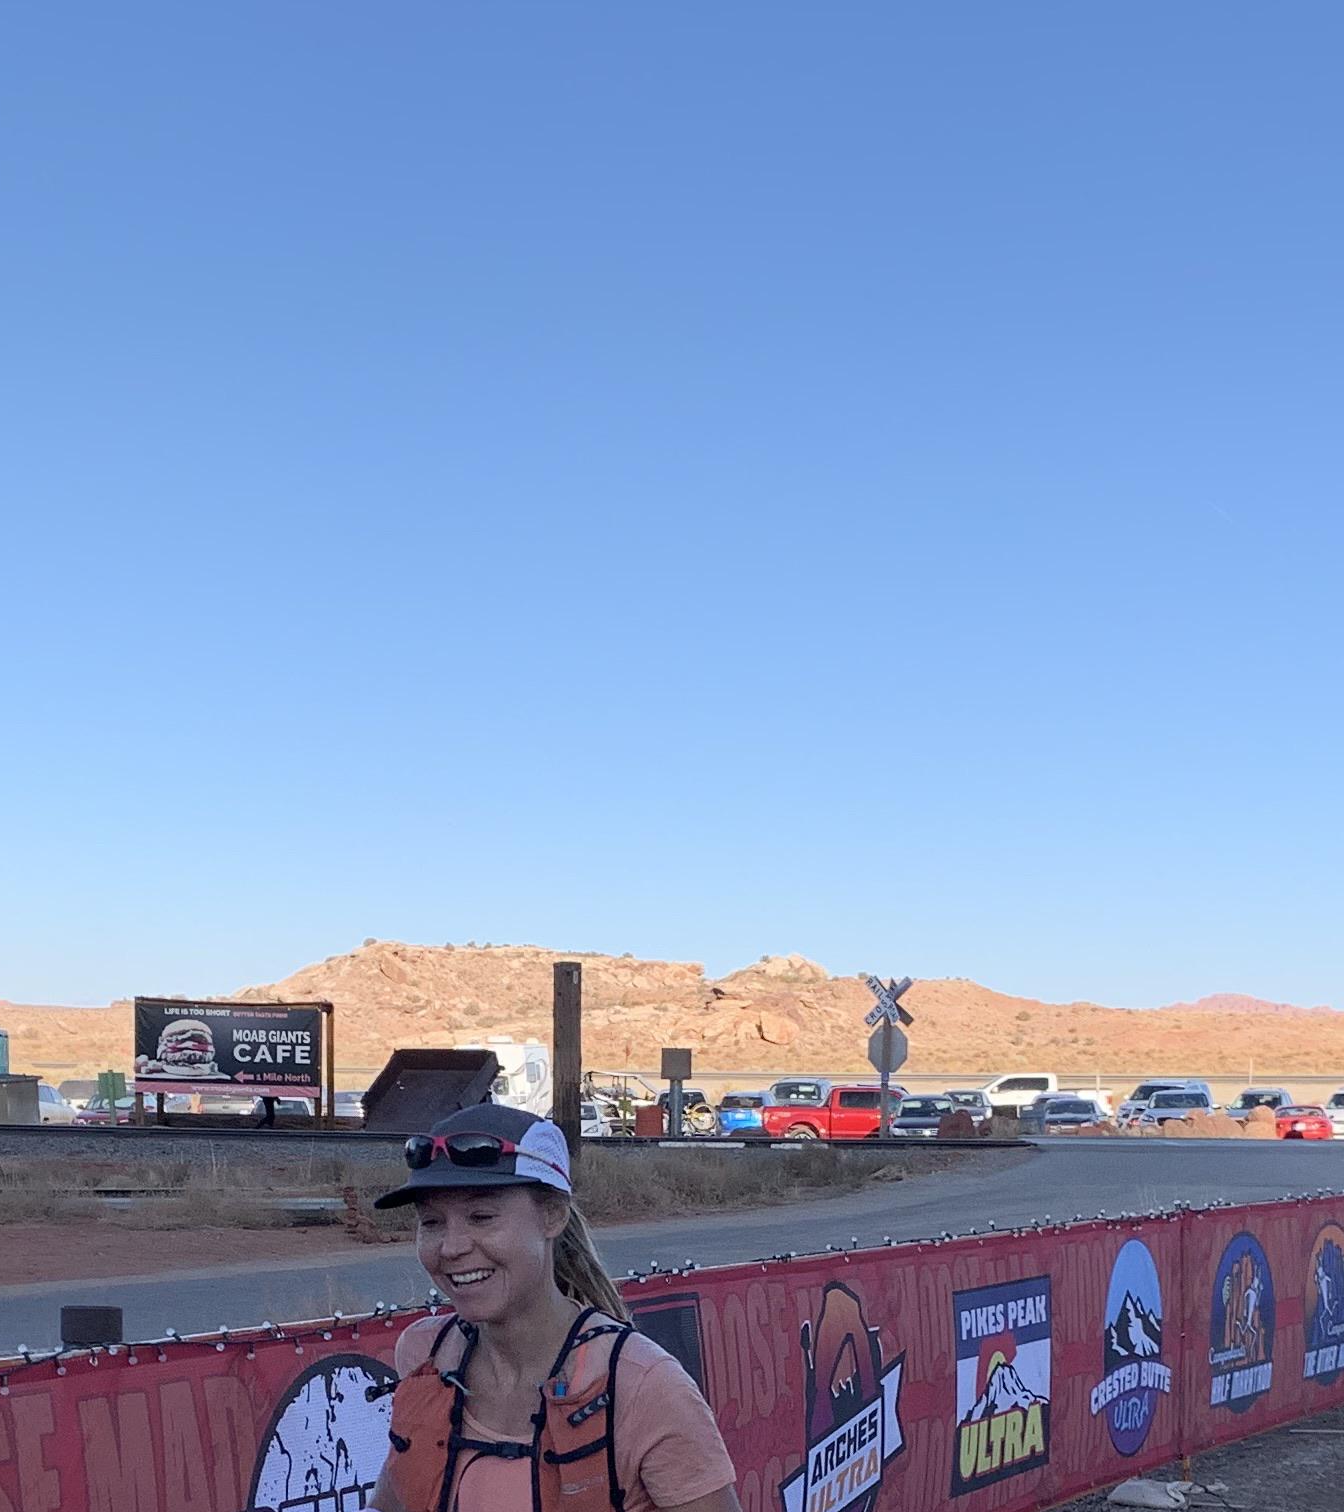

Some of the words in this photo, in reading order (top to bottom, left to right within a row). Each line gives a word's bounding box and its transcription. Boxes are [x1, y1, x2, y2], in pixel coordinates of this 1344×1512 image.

[164, 1007, 180, 1015] LIFE
[189, 1008, 204, 1016] TOO
[205, 1009, 231, 1017] SHORT
[233, 1029, 266, 1043] MOAB
[269, 1030, 311, 1044] GIANTS
[233, 1044, 311, 1065] CAFE
[263, 1073, 283, 1082] Mile
[284, 1073, 311, 1082] North
[960, 1302, 1005, 1341] PIKES
[1008, 1295, 1047, 1328] PEAK
[1090, 1367, 1139, 1416] CRESTED
[1140, 1361, 1172, 1393] BUTTE
[1113, 1389, 1149, 1432] ULTRA
[811, 1408, 879, 1488] ARCHES
[960, 1402, 1045, 1480] ULTRA
